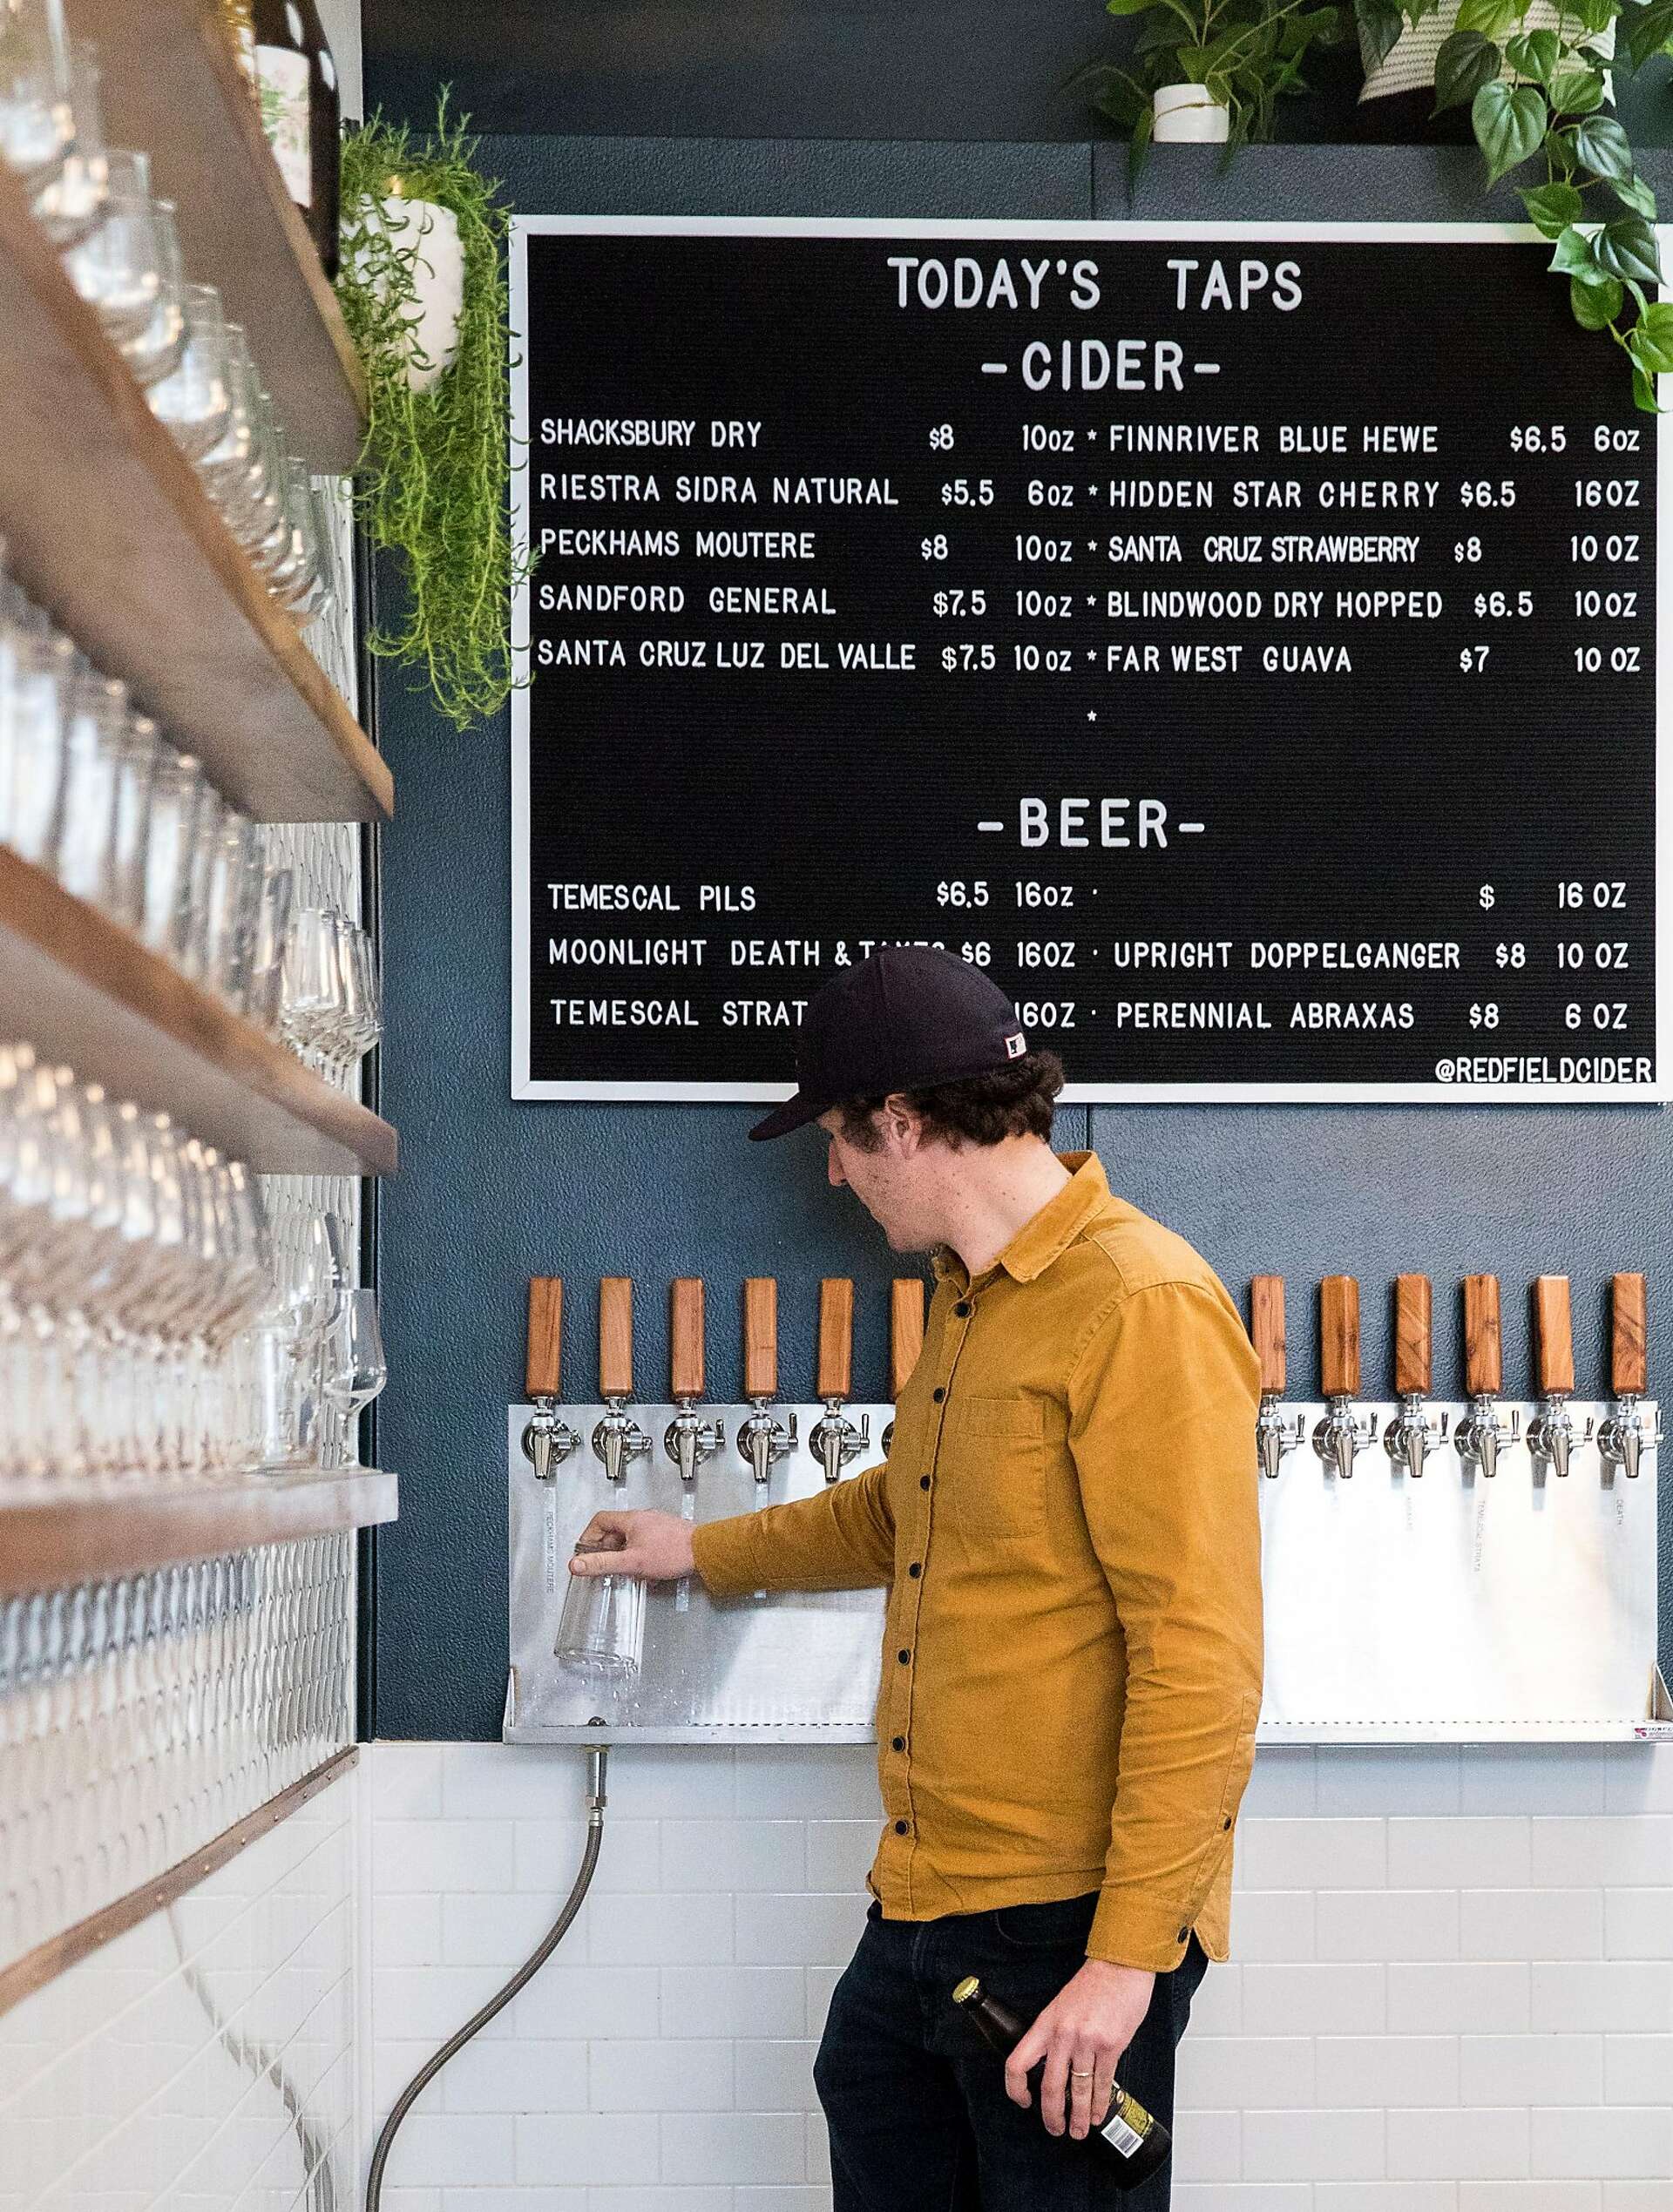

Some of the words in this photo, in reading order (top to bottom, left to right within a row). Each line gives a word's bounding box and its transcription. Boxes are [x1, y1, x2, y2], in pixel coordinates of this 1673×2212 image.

[886, 256, 1101, 310] TODAY'S
[1167, 259, 1303, 311] TAPS
[540, 417, 696, 447] SHACKSBURY
[711, 421, 762, 448] DRY
[929, 423, 955, 450] $8
[1110, 424, 1259, 453] FINNRIVER
[1279, 424, 1348, 454] BLUE
[1363, 425, 1439, 453] HEWE
[1510, 425, 1567, 453] $6.5
[540, 473, 660, 502] RIESTRA
[675, 476, 757, 504] SIDRA
[773, 477, 899, 505] NATURAL
[941, 479, 994, 507] $5.5
[1109, 480, 1213, 508] HIDDEN
[1233, 480, 1302, 508] STAR
[1318, 480, 1439, 508] CHERRY
[1460, 480, 1516, 508] $6.5
[541, 528, 680, 557] PECKHAMS
[696, 531, 816, 559] MOUTERE
[920, 534, 949, 561] $8
[1107, 535, 1182, 563] SANTA
[1203, 535, 1263, 563] CRUZ
[1270, 535, 1420, 563] STRAWBERRY
[1454, 536, 1482, 564] $8
[538, 584, 685, 613] SANDFORD
[708, 586, 836, 615] GENERAL
[932, 589, 986, 618] $7.5
[1107, 591, 1263, 619] BLINDWOOD
[1274, 591, 1324, 619] DRY
[1337, 591, 1443, 619] HOPPED
[1474, 591, 1534, 619] $6.5
[538, 639, 627, 667] SANTA
[639, 640, 707, 668] CRUZ
[716, 641, 765, 669] LUZ
[781, 641, 830, 669] DEL
[837, 642, 916, 670] VALLE
[941, 643, 996, 673] $7.5
[1107, 645, 1160, 673] FAR
[1170, 645, 1243, 673] WEST
[1263, 646, 1352, 673] GUAVA
[1460, 646, 1490, 673] $7
[547, 883, 681, 912] TEMESCAL
[700, 885, 756, 912] PILS
[937, 881, 989, 909] $6.5
[1479, 883, 1495, 911] $
[549, 937, 708, 966] MOONLIGHT
[731, 939, 820, 967] DEATH
[834, 940, 852, 966] &
[961, 941, 992, 967] $6
[1114, 941, 1233, 969] UPRIGHT
[1250, 942, 1460, 970] DOPPELGANGER
[1495, 942, 1526, 969] $8
[550, 998, 700, 1026] TEMESCAL
[722, 1000, 809, 1026] STRAT
[1117, 1002, 1272, 1030] PERENNIAL
[1290, 1002, 1414, 1030] ABRAXAS
[1469, 1003, 1500, 1030] $8
[1433, 1056, 1652, 1084] @REDFIELDCIDER
